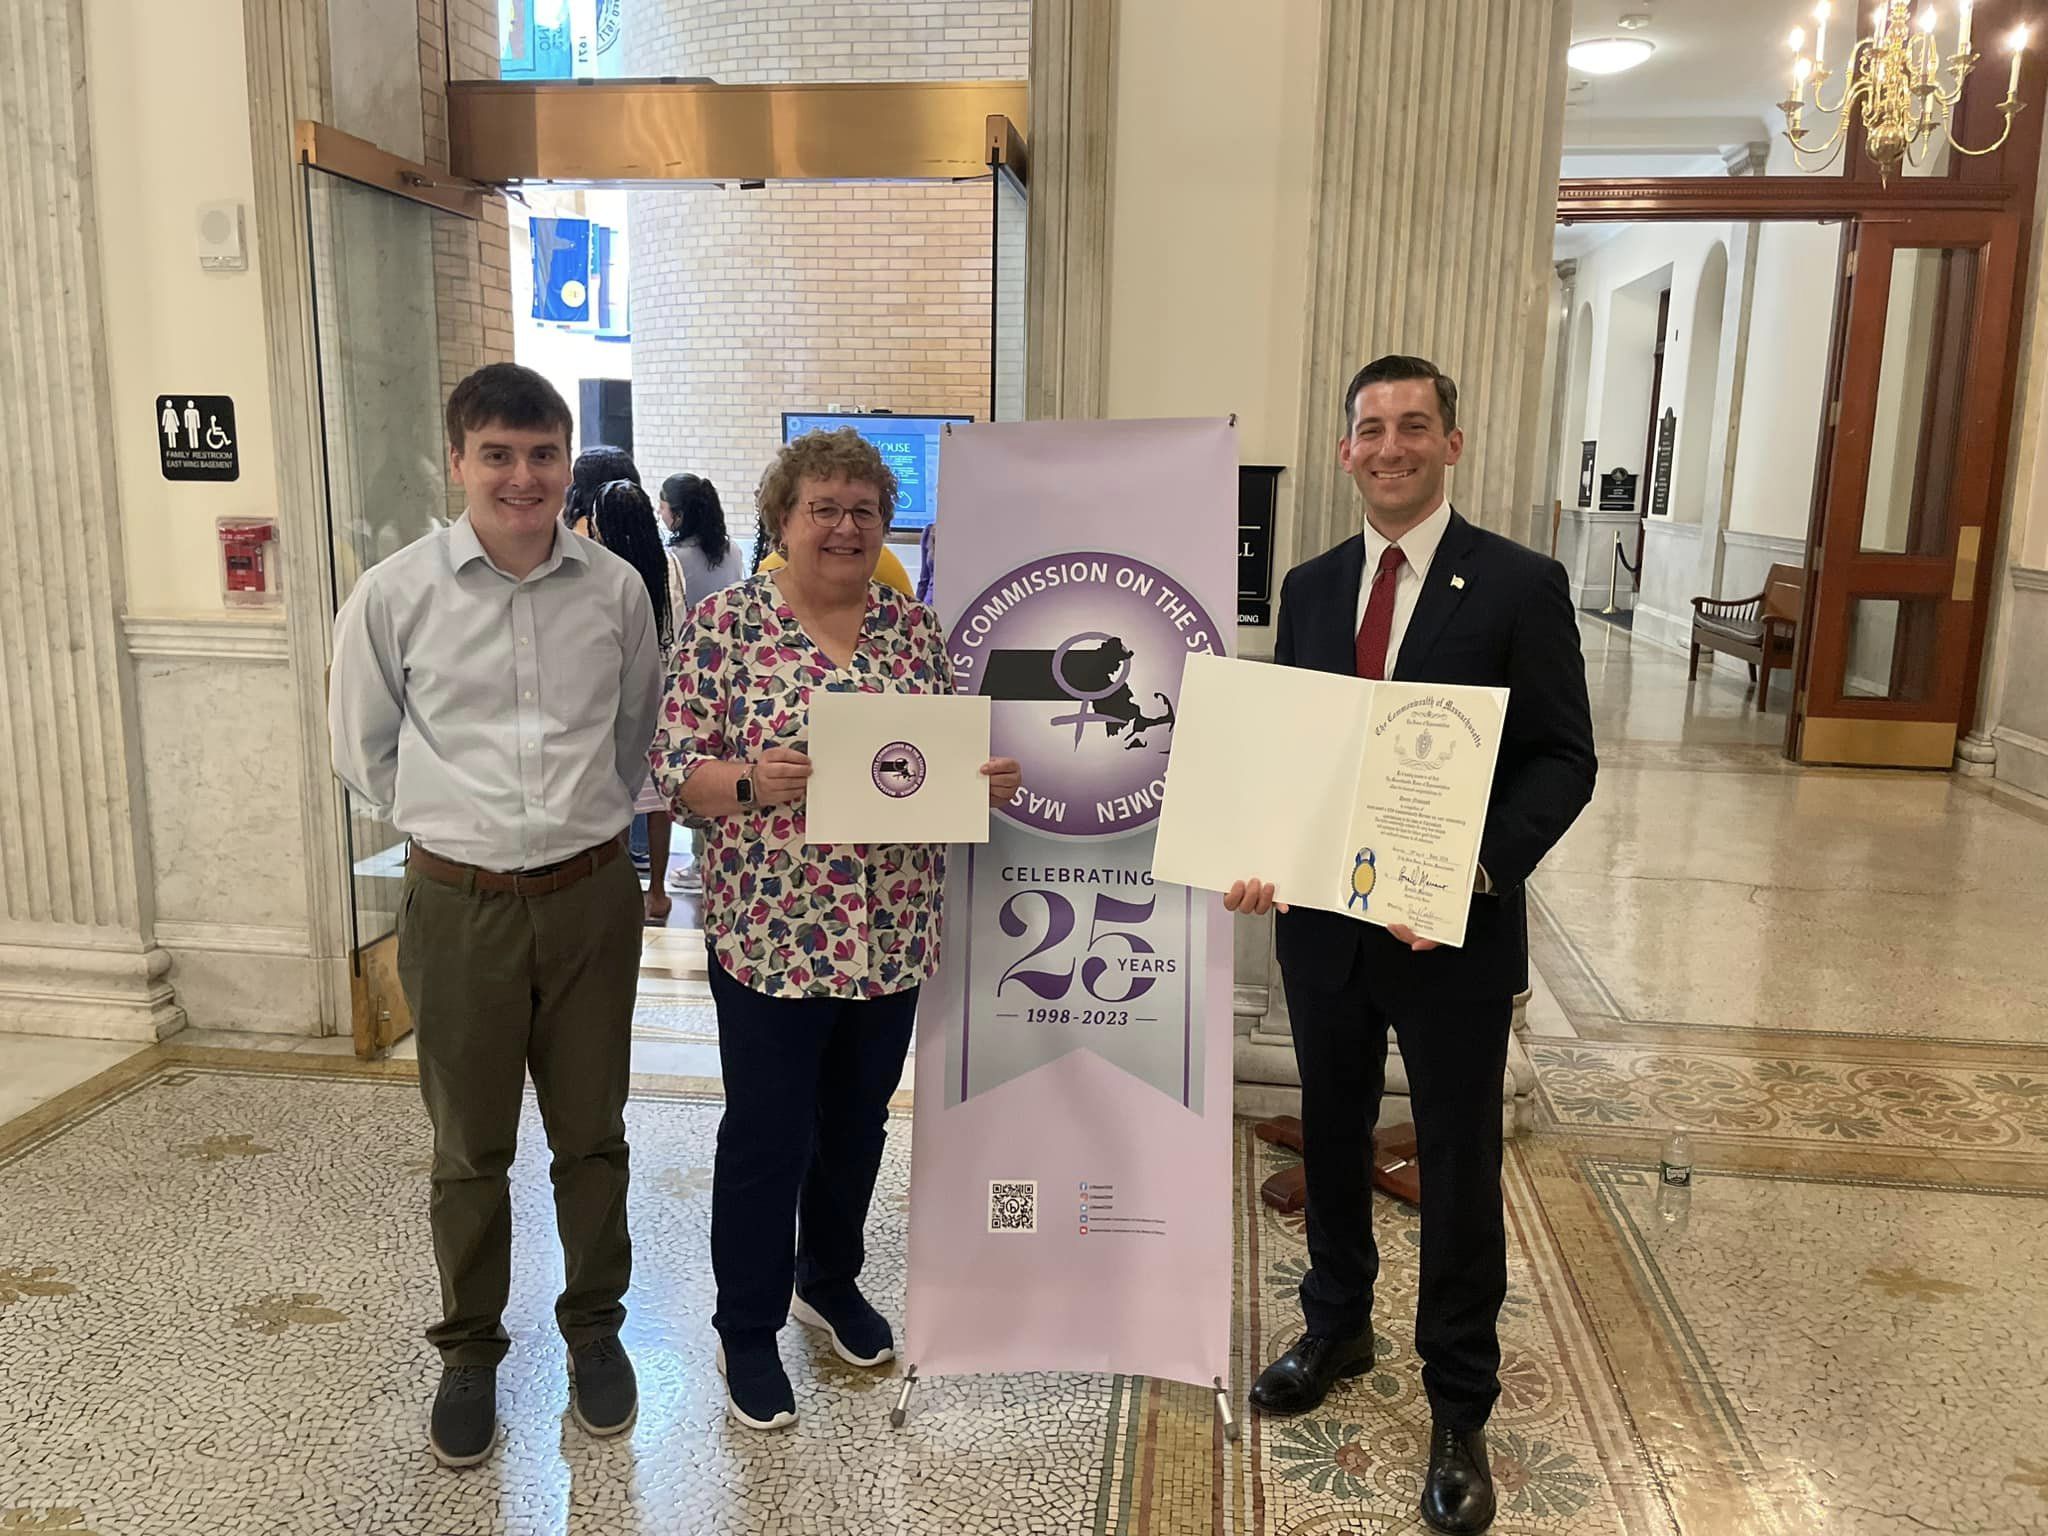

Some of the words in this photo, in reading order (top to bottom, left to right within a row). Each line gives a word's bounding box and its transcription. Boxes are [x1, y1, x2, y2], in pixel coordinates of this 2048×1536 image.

[192, 451, 232, 459] RESTROOM
[878, 441, 910, 452] OUSE
[1115, 567, 1154, 596] ON
[962, 562, 1108, 647] COMMISSION
[1157, 587, 1197, 631] THE
[1238, 614, 1259, 623] DING
[1096, 779, 1166, 823] OMEN
[1002, 867, 1154, 885] CELEBRATING
[997, 889, 1156, 1002] 25
[1117, 958, 1176, 973] YEARS
[1026, 1008, 1129, 1026] 1998-2023
